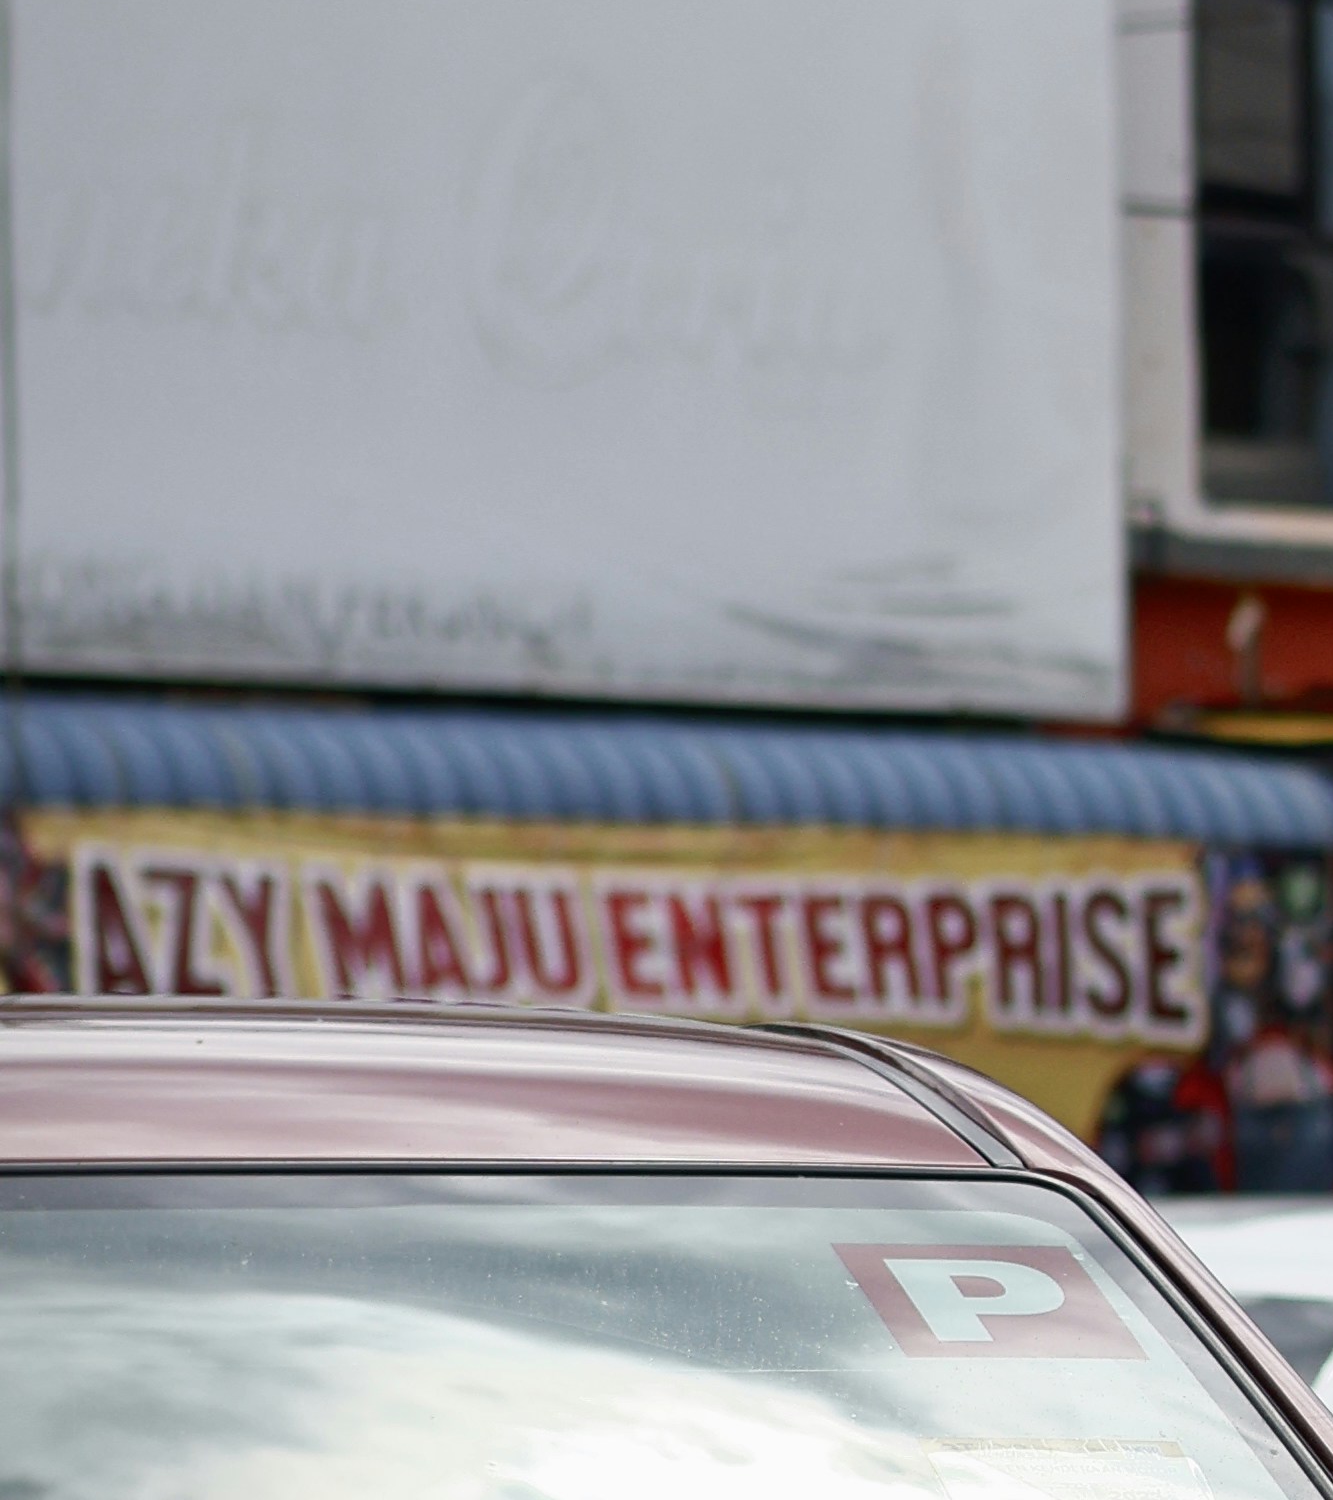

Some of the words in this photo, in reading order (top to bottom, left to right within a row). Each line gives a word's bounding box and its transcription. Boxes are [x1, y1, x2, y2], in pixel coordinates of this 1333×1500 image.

[86, 856, 284, 997] AZY
[310, 874, 582, 999] MAJU
[602, 884, 1194, 1024] ENTERPRISE
[884, 1258, 1066, 1343] P
